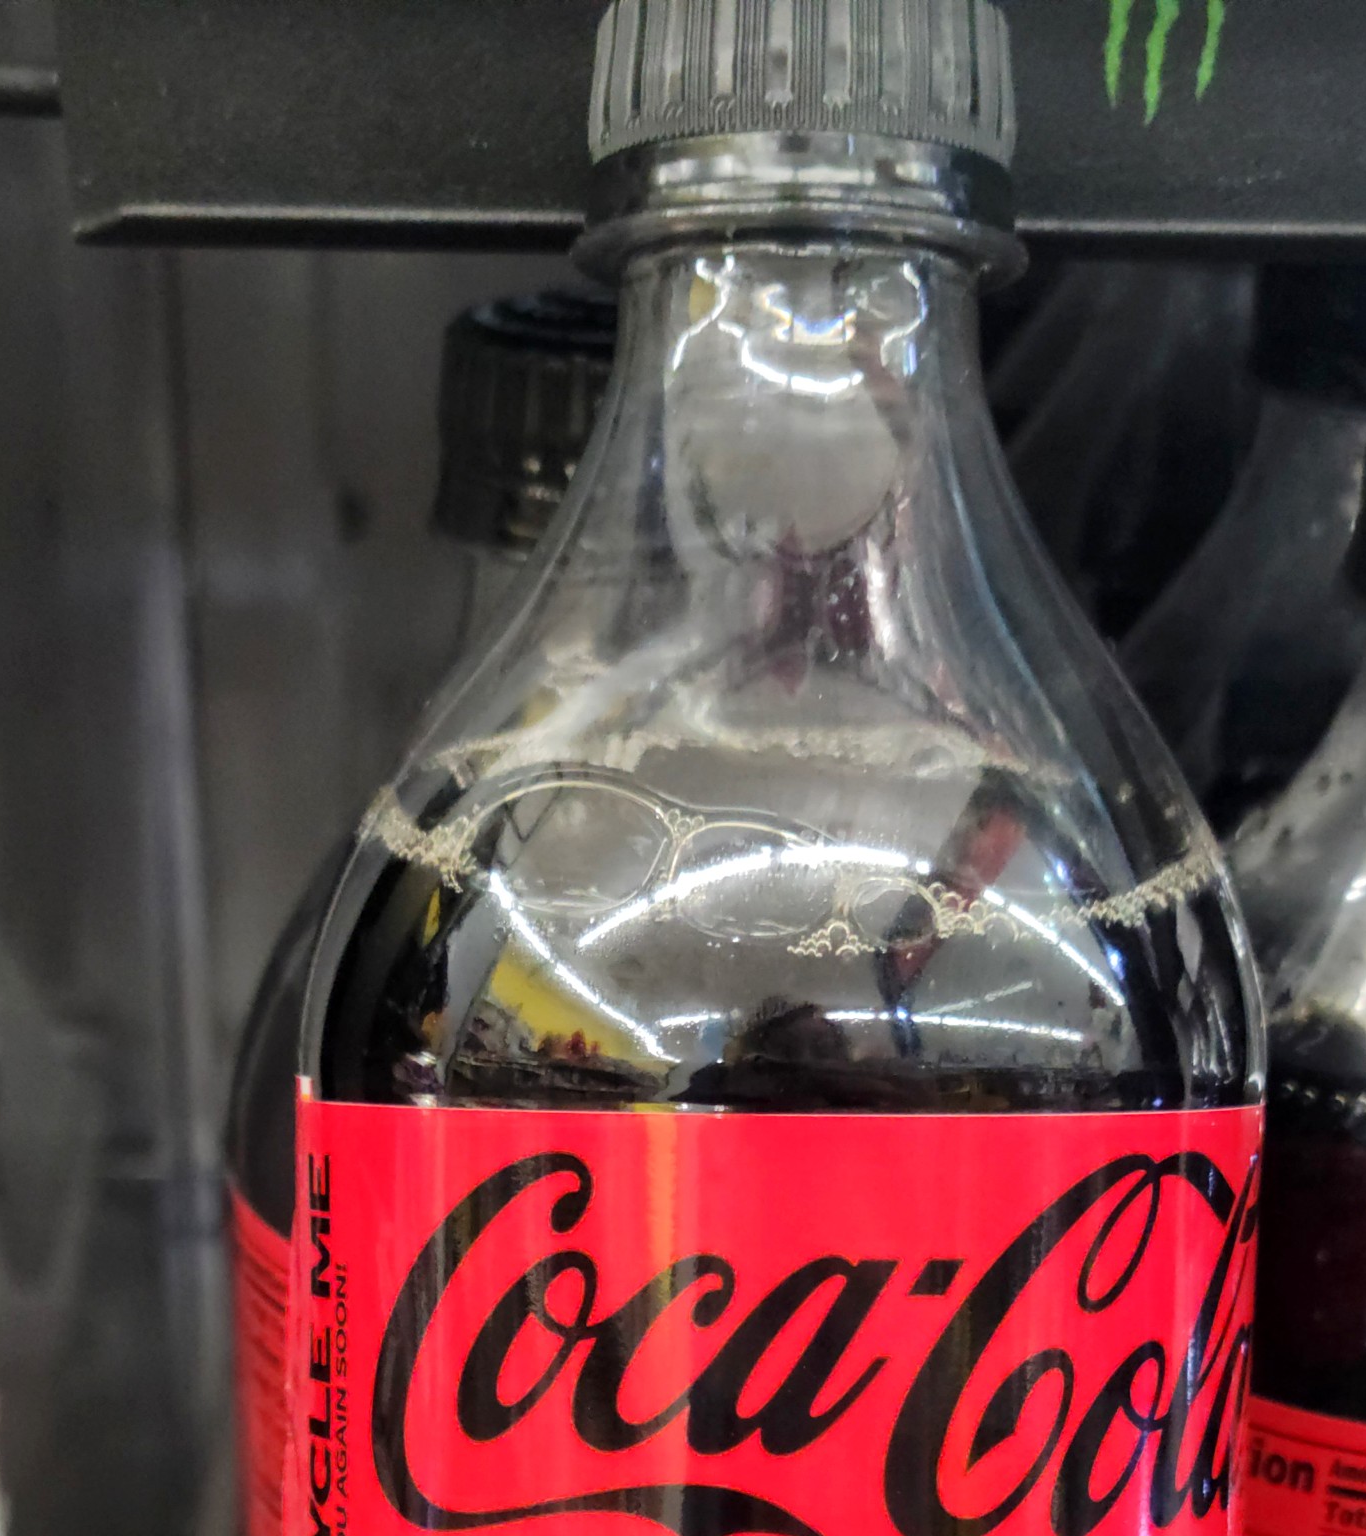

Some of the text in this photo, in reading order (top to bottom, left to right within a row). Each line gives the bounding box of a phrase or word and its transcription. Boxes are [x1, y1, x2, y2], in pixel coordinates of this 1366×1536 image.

[308, 1152, 334, 1299] ME
[334, 1262, 349, 1377] SOON!
[334, 1386, 349, 1494] AGAIN
